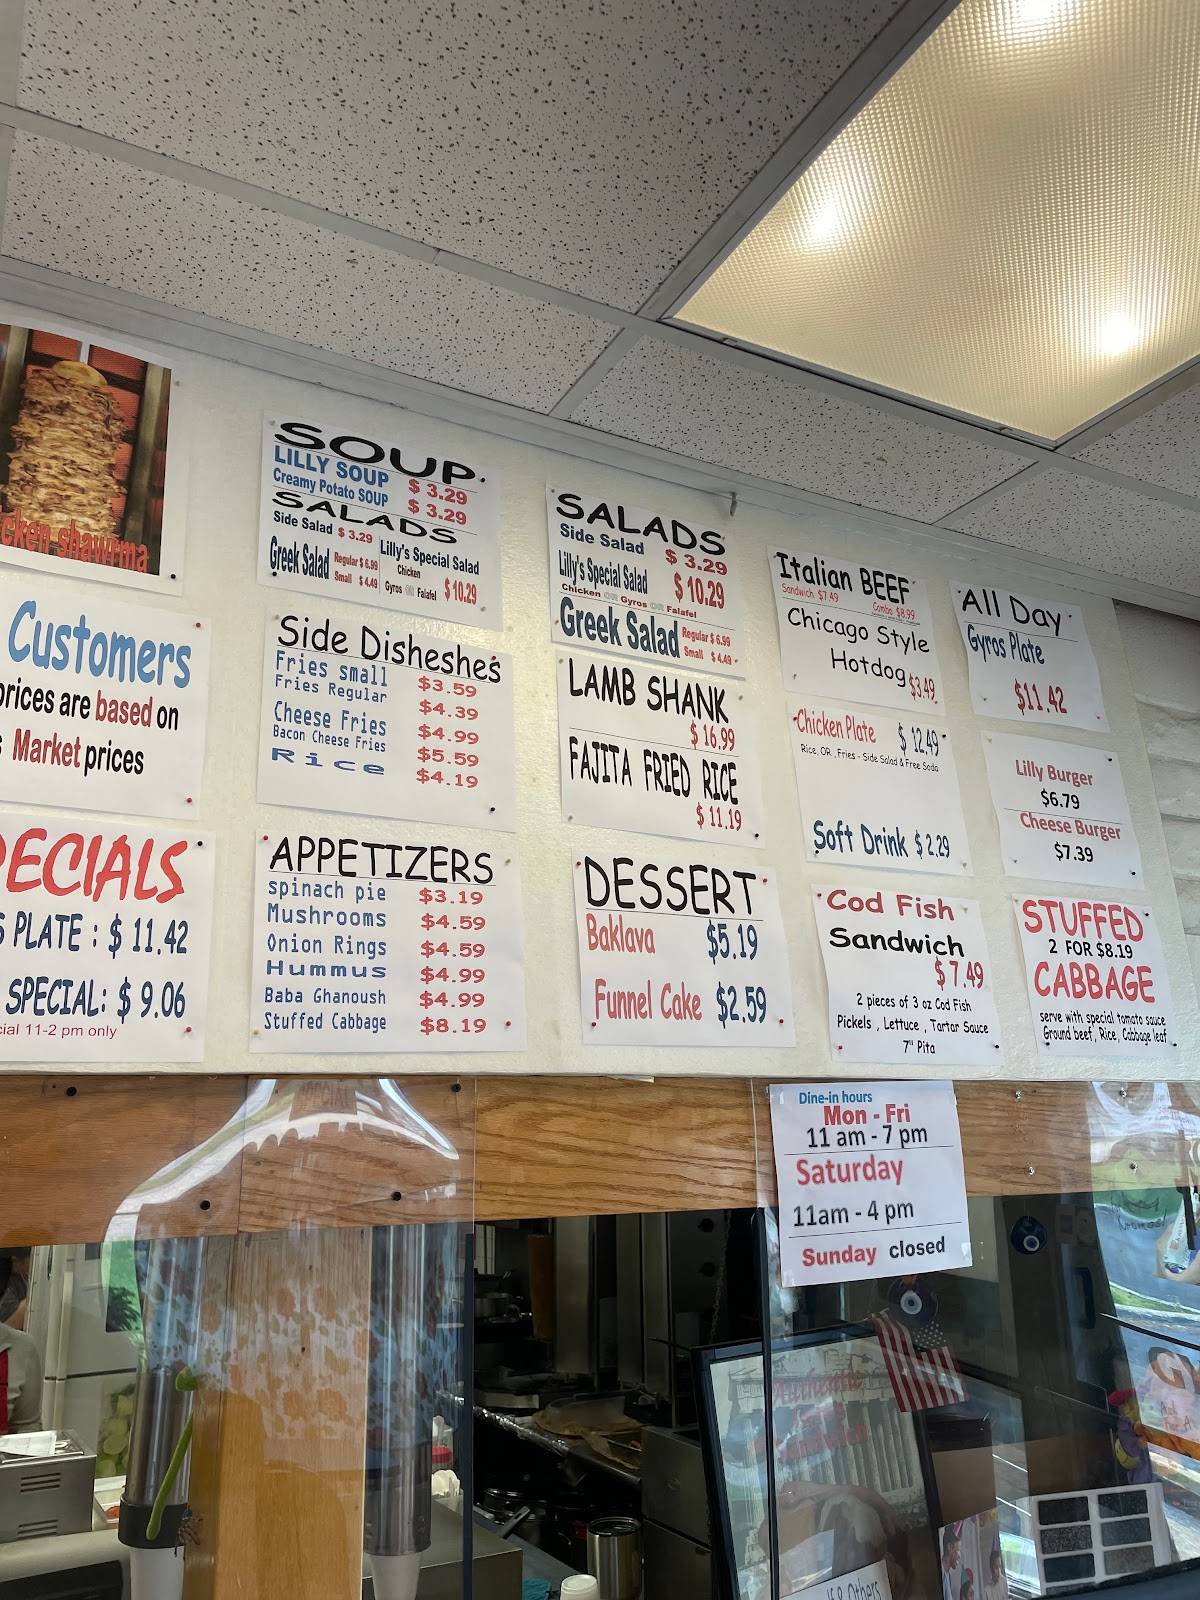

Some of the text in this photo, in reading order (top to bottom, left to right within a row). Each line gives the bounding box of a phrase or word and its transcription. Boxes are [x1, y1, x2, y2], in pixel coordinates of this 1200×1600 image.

[274, 422, 476, 485] SOUP
[275, 445, 389, 488] LILLY SOUP
[273, 468, 388, 507] Creamy Potato SOUP
[272, 492, 457, 544] SALADS
[273, 511, 333, 534] Side Salad
[556, 493, 726, 556] SALADS
[560, 523, 645, 555] Side Salad
[270, 536, 329, 579] Greek Salad
[335, 552, 358, 566] Regular
[381, 540, 479, 575] Lilly's Special Salad
[398, 565, 420, 578] Chicken
[558, 550, 648, 594] Lilly's Special Salad
[335, 571, 352, 583] Small
[385, 581, 436, 600] Gyros Falafel
[776, 552, 910, 604] Italian BEEF
[782, 583, 814, 598] Sandwich
[562, 584, 697, 619] Chicken Gyros Falafel
[962, 589, 1061, 636] All Day
[8, 600, 191, 688] Customers
[560, 597, 680, 658] Greek Salad
[682, 627, 708, 643] Regular
[788, 608, 930, 655] Chicago Style
[968, 624, 1045, 664] Gyros Plate
[277, 615, 501, 684] Side Disheshes
[684, 646, 703, 660] Small
[276, 650, 477, 697] Fries small $3.59
[831, 648, 906, 688] Hotdog
[275, 674, 478, 721] Fries Regular $4.39
[569, 658, 728, 724] LAMB SHANK
[909, 674, 935, 700] $3.49
[1014, 678, 1067, 715] $11.42
[59, 691, 90, 719] are
[96, 690, 153, 727] based
[157, 706, 178, 730] on
[274, 701, 479, 745] Cheese Fries $4.99
[796, 708, 876, 743] Chicken Plate
[13, 728, 144, 777] Market prices
[273, 724, 479, 767] Bacon Cheese Fries $5.59
[863, 753, 939, 772] Side Salad Free Soda
[272, 747, 478, 788] Rice $4.19
[569, 736, 738, 805] FAJITA FRIED RICE
[1015, 759, 1093, 787] Lilly Burger
[1041, 788, 1080, 809] $6.79
[814, 820, 908, 858] Soft Drink
[1020, 812, 1120, 841] Cheese Burger
[269, 836, 493, 884] APPETIZERS
[1054, 841, 1093, 862] $7.39
[268, 878, 483, 905] spinach pie $3.19
[584, 856, 757, 915] DESSERT
[267, 903, 486, 931] Mushrooms $4.59
[827, 889, 954, 921] Cod Fish
[1022, 900, 1144, 942] STUFFED
[14, 911, 83, 951] PLATE
[267, 933, 485, 960] Onion Rings $4.59
[586, 913, 758, 965] Baklava $5.19
[830, 927, 964, 957] Sandwich
[1066, 941, 1133, 959] FOR $8.19
[266, 960, 485, 984] Hummus $4.99
[1034, 961, 1155, 1003] CABBAGE
[5, 976, 106, 1017] SPECIAL:
[264, 987, 485, 1008] Baba Ghanoush $4.99
[595, 978, 767, 1029] Funnel Cake $2.59
[867, 994, 971, 1012] pieces of Cod Fish
[26, 1024, 117, 1039] 11-2 pm only
[264, 1012, 486, 1035] Stuffed Cabbage $8.19
[837, 1014, 988, 1033] Pickels Lettuce Tartar Sauce
[1040, 1010, 1166, 1026] serve with special tomato sauce
[1044, 1025, 1167, 1045] Ground Cabbage leaf
[917, 1040, 935, 1054] Pita
[799, 1091, 872, 1104] Dine-in hours
[824, 1104, 910, 1125] Mon Fri
[807, 1127, 927, 1148] 11 am pm
[796, 1154, 903, 1186] Saturday
[794, 1202, 914, 1227] 11am pm
[802, 1236, 945, 1267] Sunday closed
